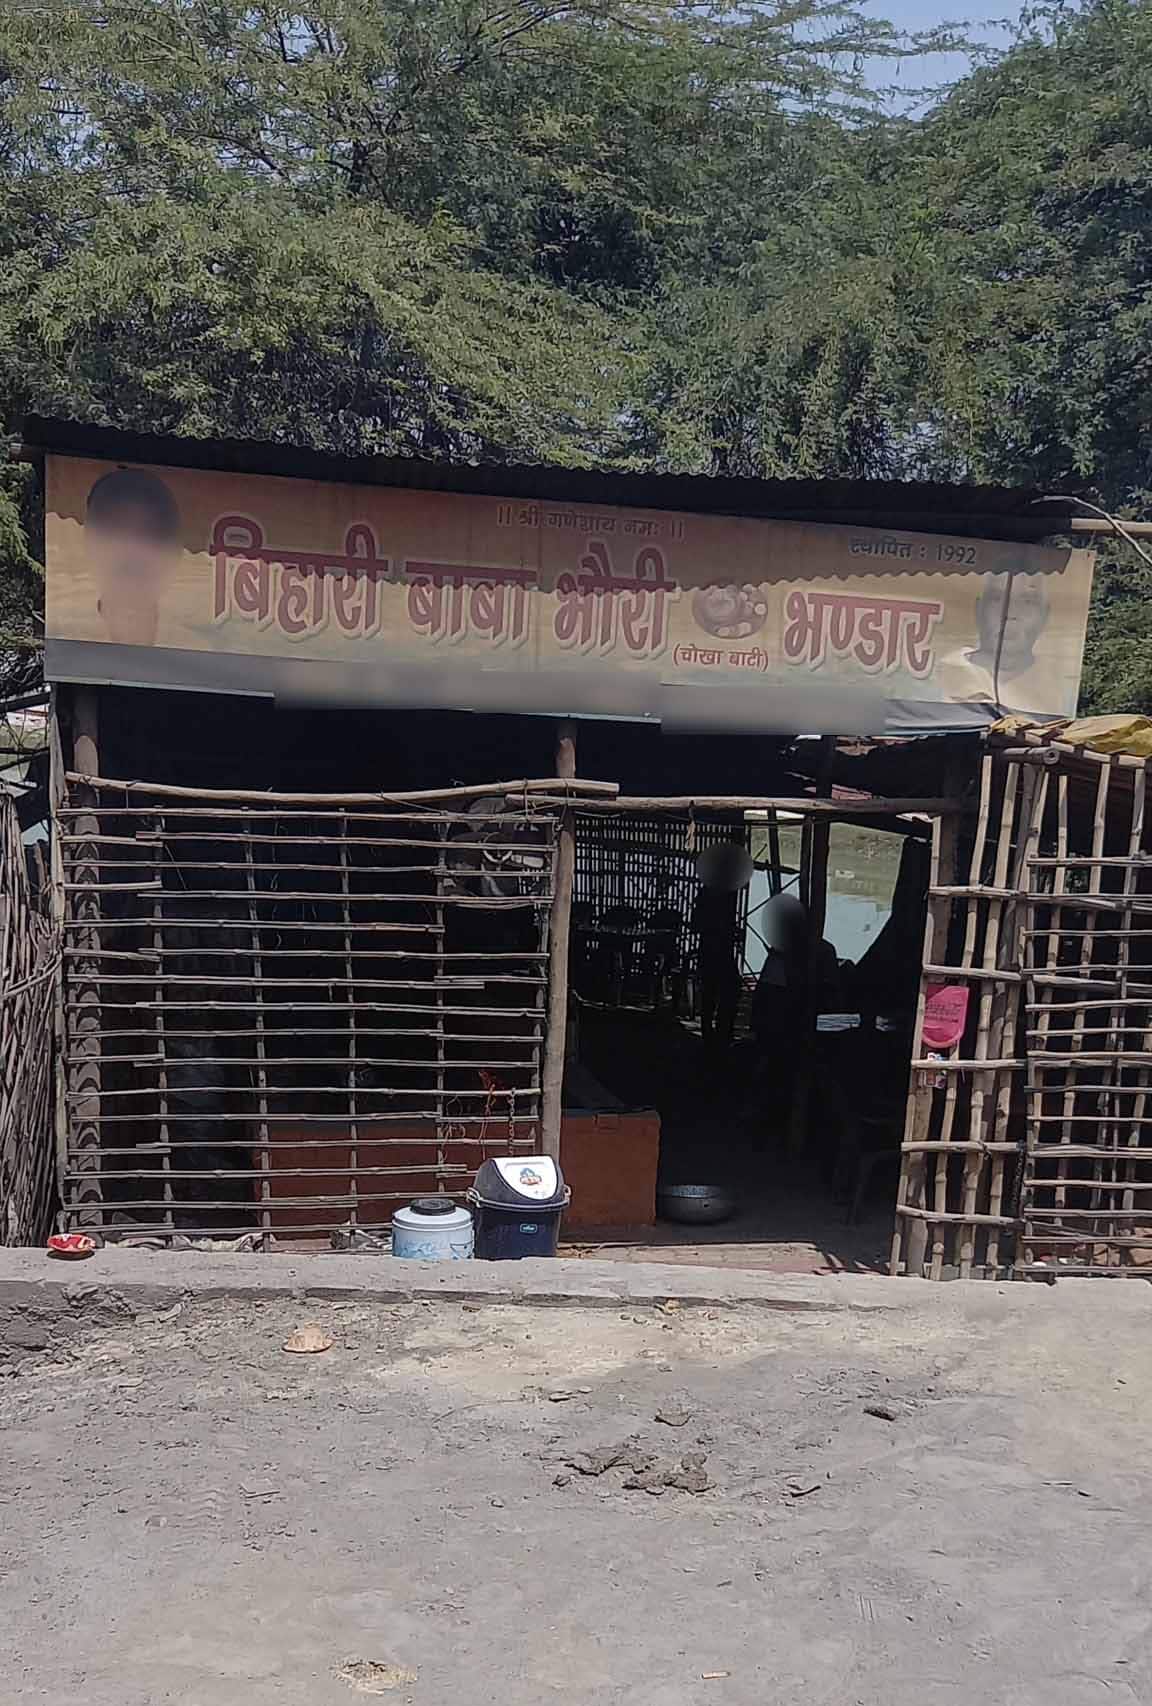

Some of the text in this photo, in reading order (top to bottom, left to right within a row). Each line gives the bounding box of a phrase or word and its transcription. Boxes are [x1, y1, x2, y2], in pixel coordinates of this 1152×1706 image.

[520, 505, 539, 524] श्री
[548, 511, 616, 531] गणेशाय
[937, 543, 977, 564] 1992
[209, 516, 941, 672] बिहारी बाबा भौरी भण्डार
[673, 643, 769, 672] (चोखा बाटी)
